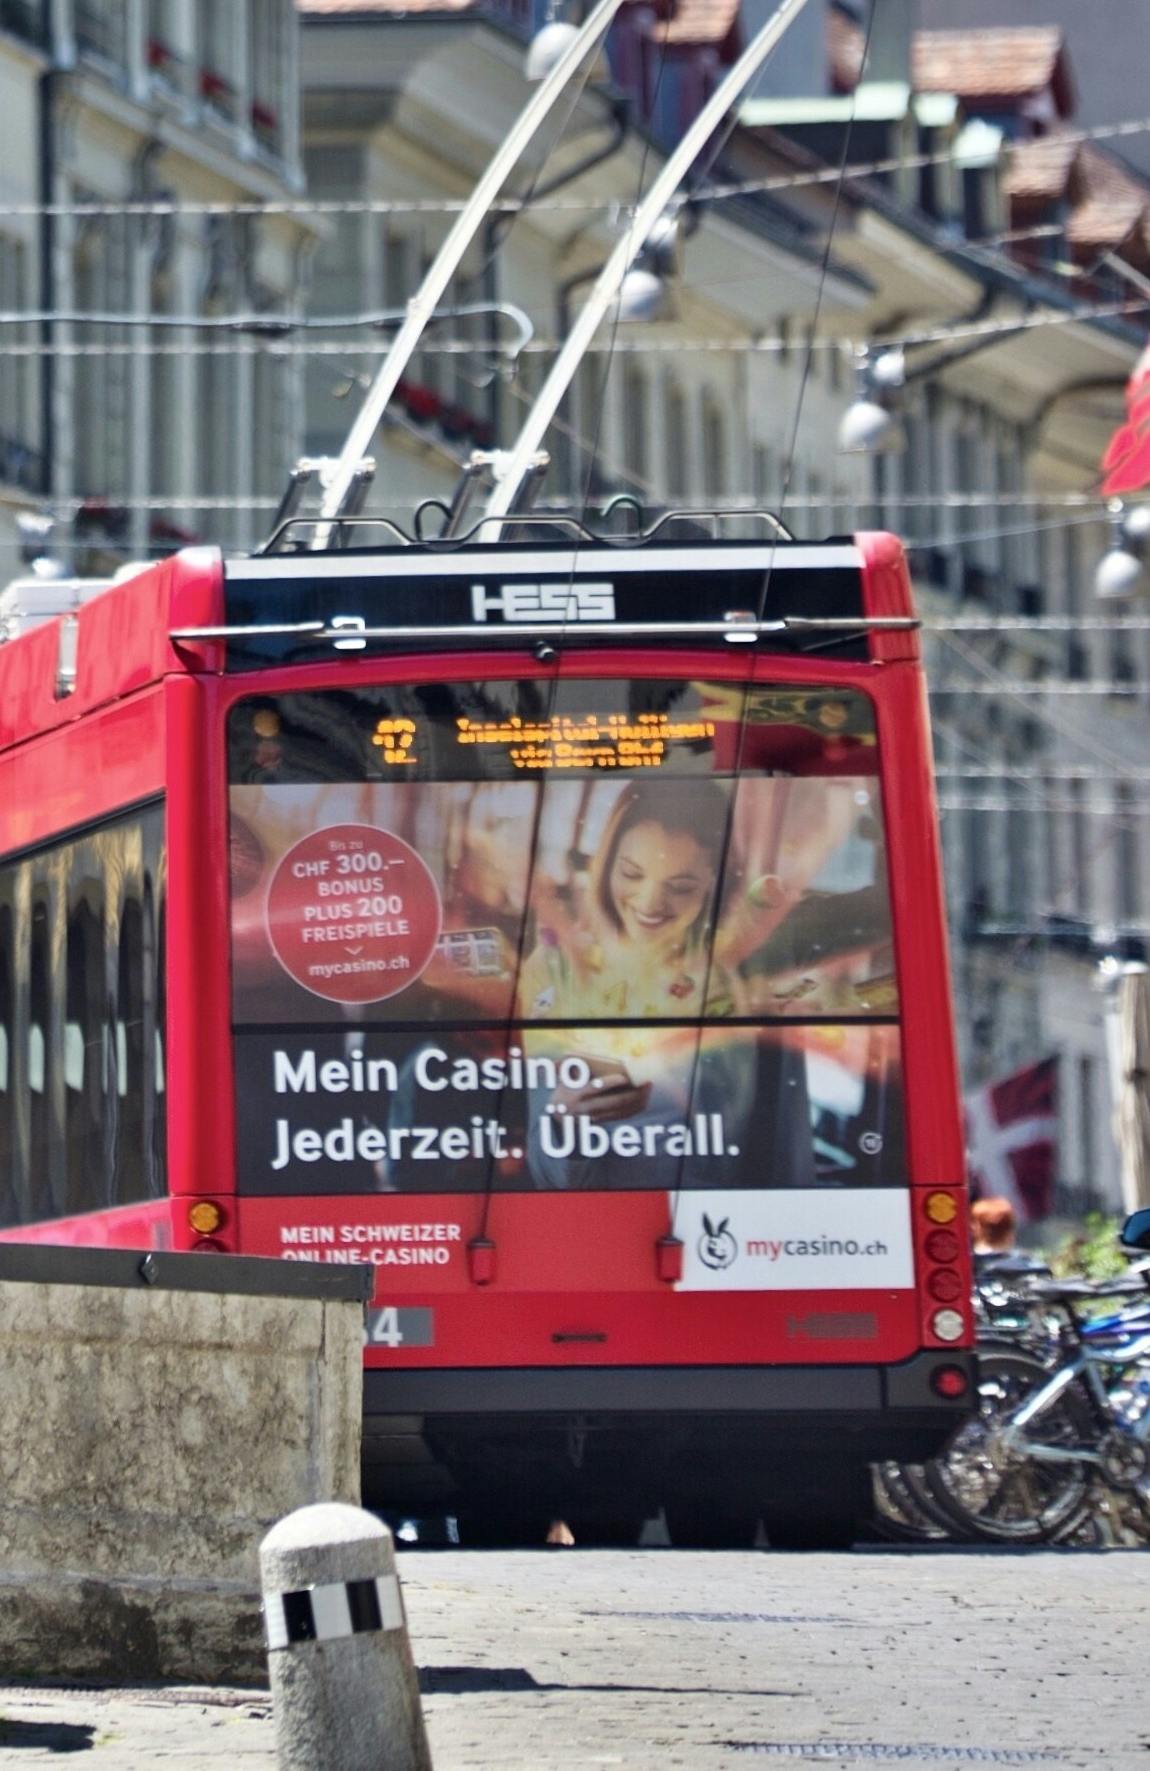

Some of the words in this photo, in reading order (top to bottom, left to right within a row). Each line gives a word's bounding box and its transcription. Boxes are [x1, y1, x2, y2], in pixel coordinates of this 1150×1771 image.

[471, 583, 616, 621] HESS
[329, 841, 346, 851] Bis
[292, 860, 330, 877] CHF
[317, 877, 384, 897] BONUS
[304, 903, 353, 921] PLUS
[357, 896, 403, 917] 200
[302, 920, 410, 943] FREISPIELE
[309, 956, 410, 978] mycasino.ch
[273, 1050, 398, 1093] Mein
[414, 1047, 603, 1092] Casino.
[271, 1115, 523, 1170] Jederzeit.
[539, 1103, 740, 1157] Überall.
[280, 1226, 334, 1243] MEIN
[340, 1224, 461, 1242] SCHWEIZER
[746, 1235, 887, 1261] mycasino.ch
